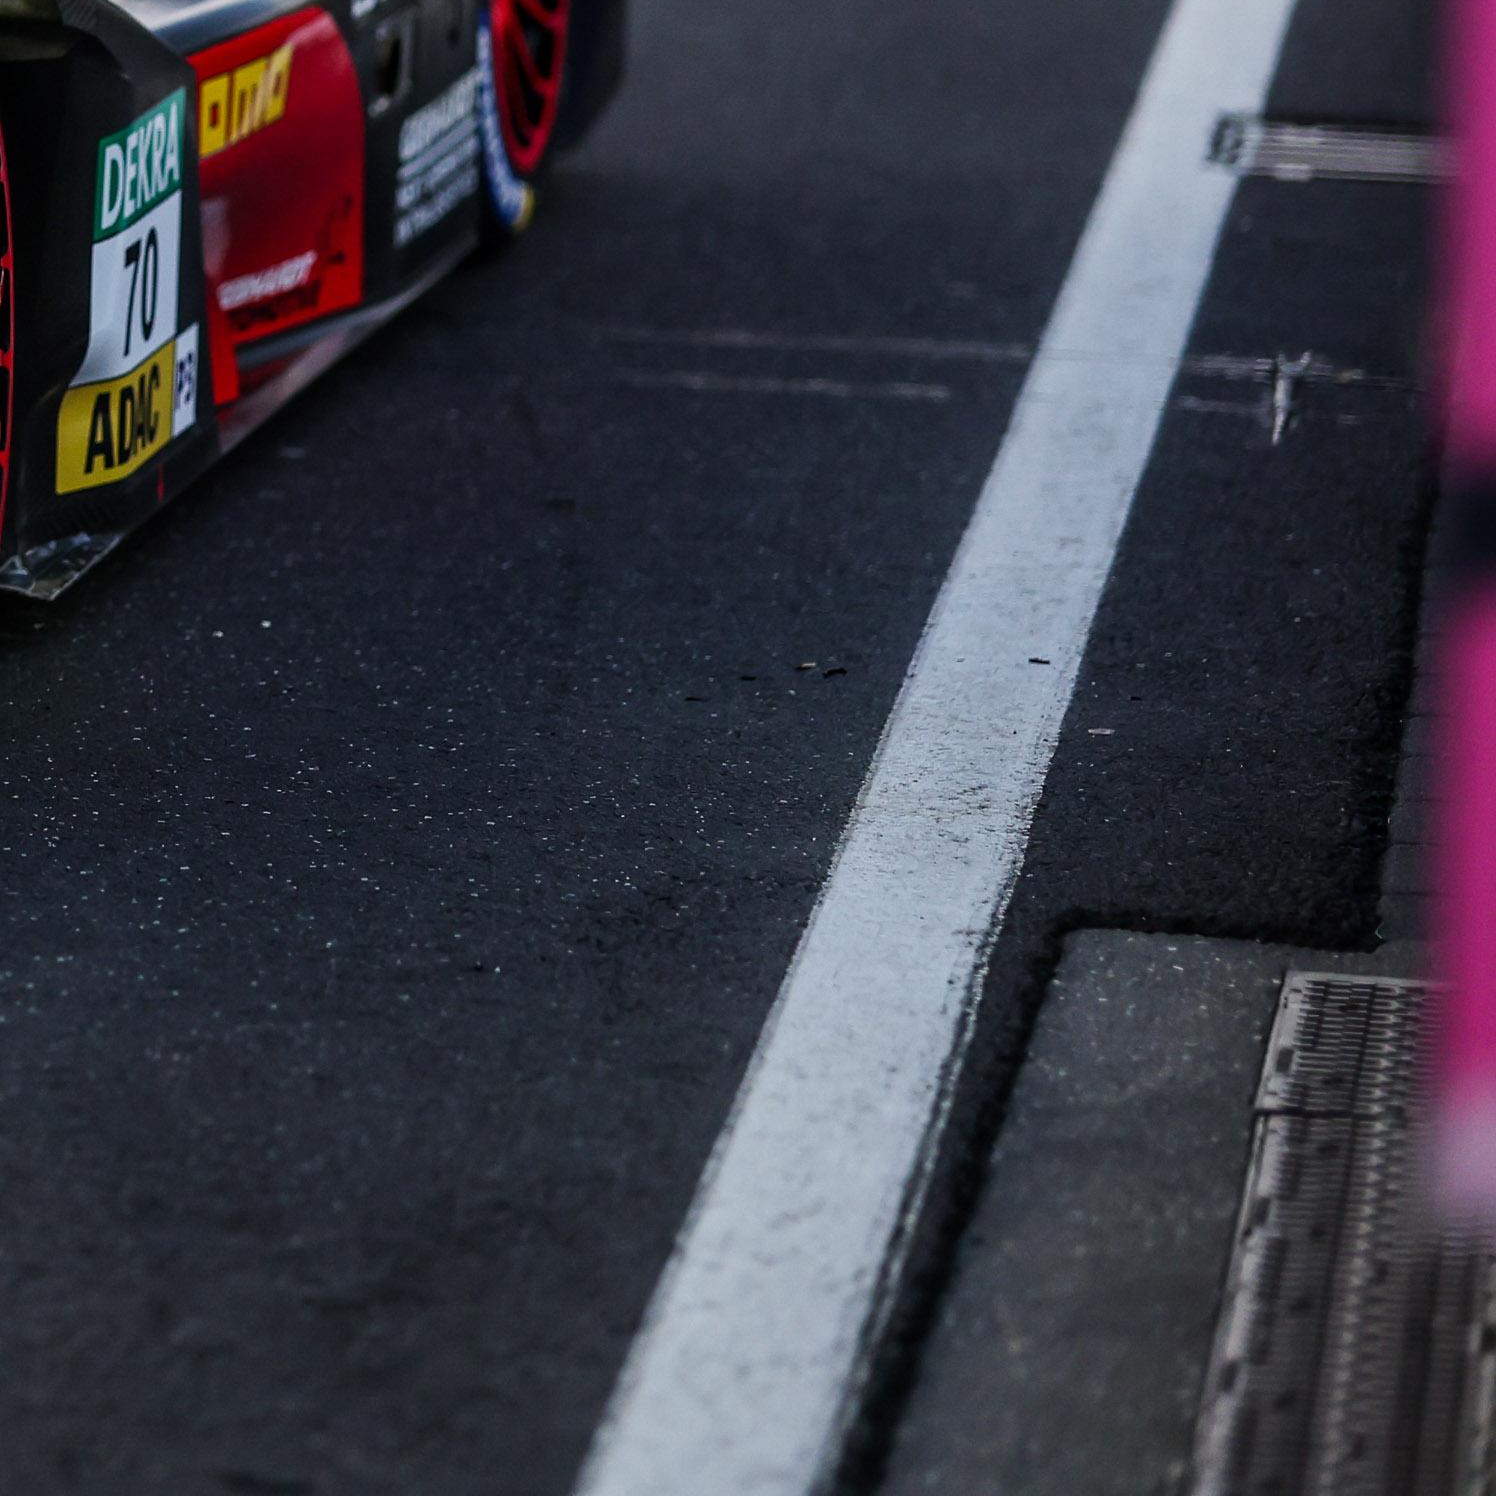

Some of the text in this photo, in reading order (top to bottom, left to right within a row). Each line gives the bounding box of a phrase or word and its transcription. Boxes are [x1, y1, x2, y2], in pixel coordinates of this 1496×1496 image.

[100, 99, 181, 231] DEKRA
[122, 224, 159, 358] 70
[83, 360, 161, 475] ADAC
